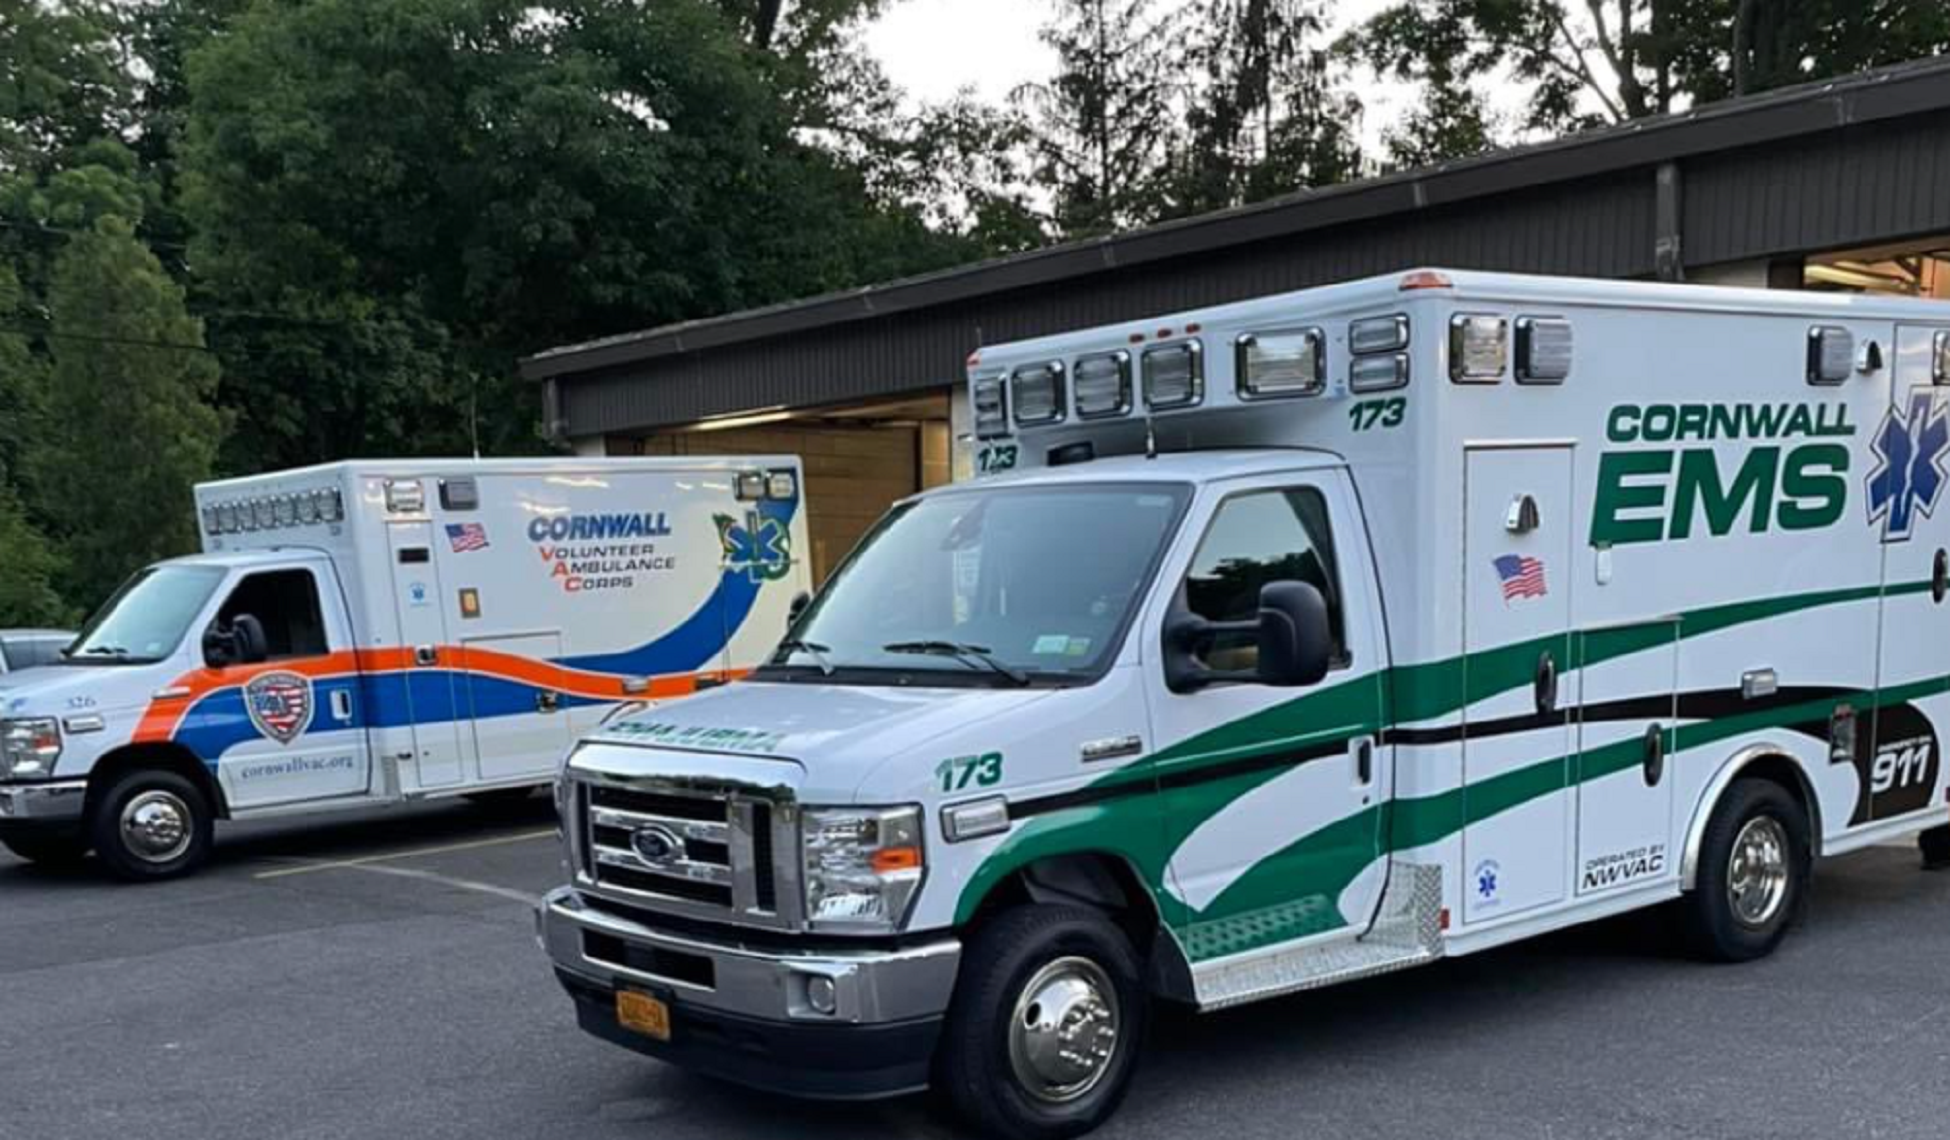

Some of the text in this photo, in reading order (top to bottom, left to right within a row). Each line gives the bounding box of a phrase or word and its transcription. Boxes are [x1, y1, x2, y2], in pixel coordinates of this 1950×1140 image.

[1349, 396, 1407, 431] 173
[1607, 403, 1856, 443] CORNWALL
[1589, 443, 1850, 548] EMS
[528, 512, 671, 541] CORNWALL
[539, 544, 654, 561] VOLUNTEER
[552, 557, 675, 577] AMBULANCE
[564, 576, 634, 592] CORPS
[241, 757, 354, 779] cornwallvac.org
[935, 751, 1002, 792] 173
[1871, 744, 1931, 793] 911
[1582, 855, 1664, 890] NWVAC
